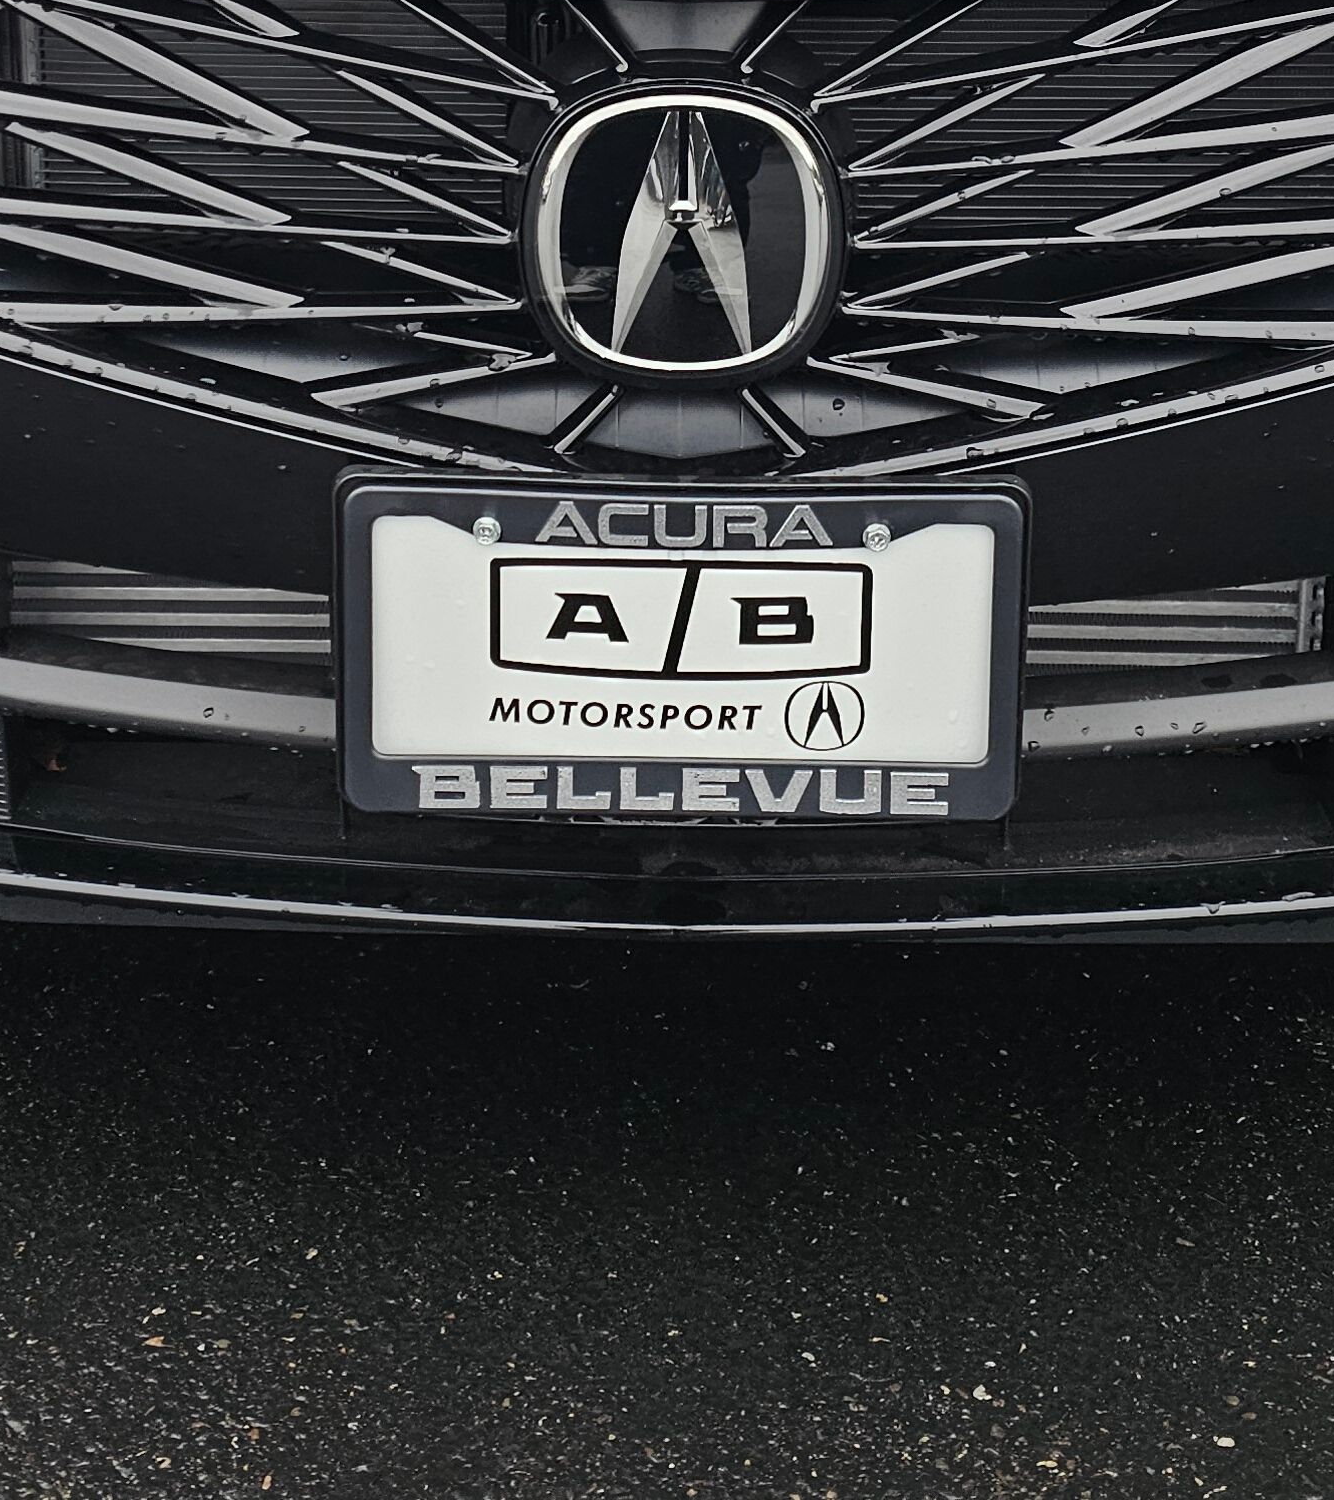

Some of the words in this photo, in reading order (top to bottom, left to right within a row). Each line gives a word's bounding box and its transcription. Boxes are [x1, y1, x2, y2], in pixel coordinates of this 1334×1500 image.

[534, 499, 834, 550] ACURA
[545, 591, 628, 644] A
[730, 595, 815, 646] B
[488, 696, 763, 732] MOTORSPORT
[410, 764, 950, 816] BELLEVUE
